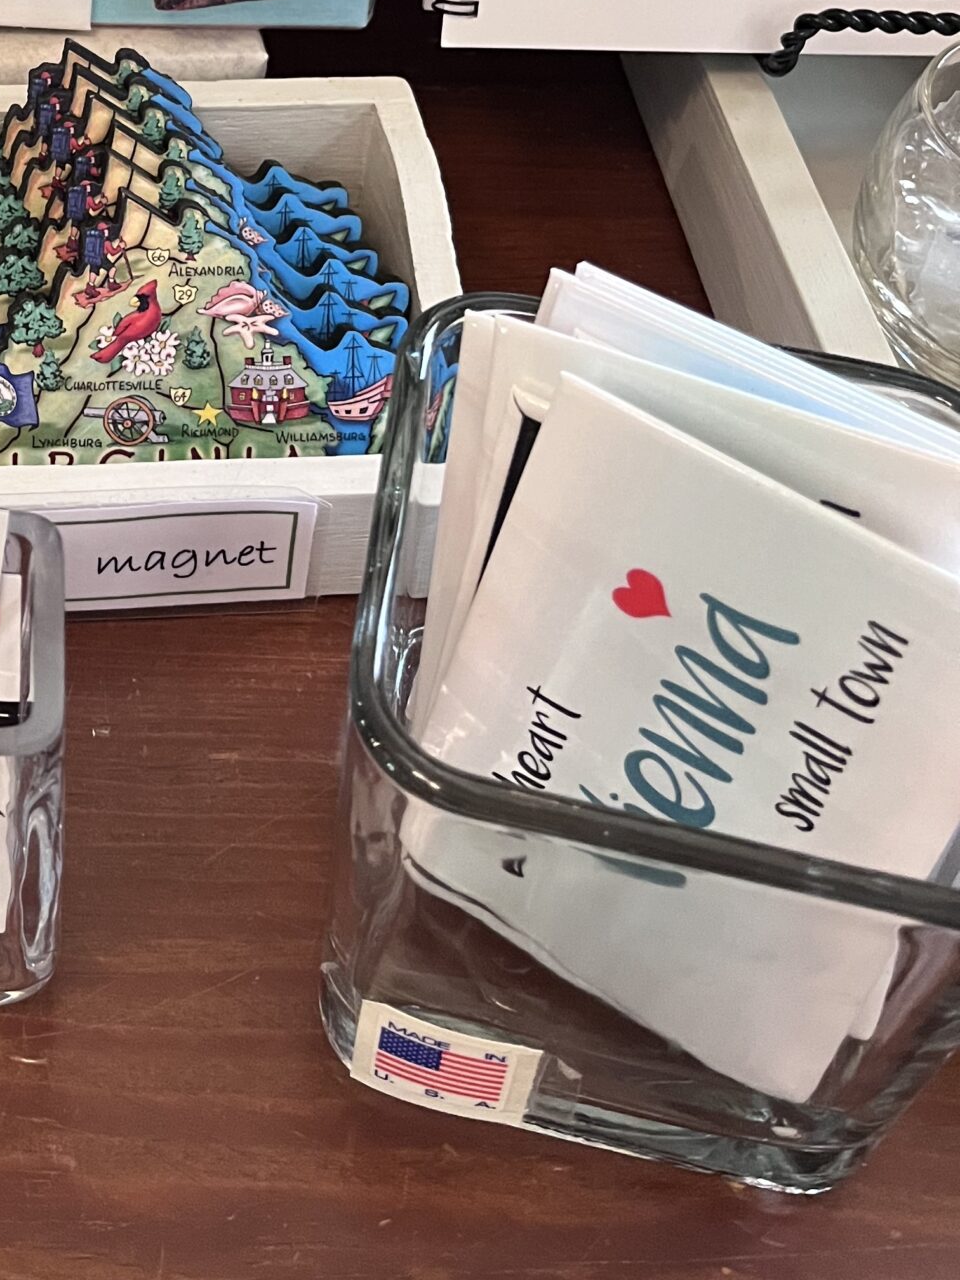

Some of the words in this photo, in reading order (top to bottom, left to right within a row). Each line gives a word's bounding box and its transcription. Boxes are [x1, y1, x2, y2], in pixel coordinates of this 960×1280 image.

[151, 251, 166, 262] 66
[168, 262, 245, 278] ALEXANDRIA
[177, 289, 193, 301] 29
[64, 375, 164, 392] CHARLOTTESVILLE
[173, 391, 188, 403] 64
[31, 435, 103, 449] LYNCHBURG
[275, 432, 368, 445] WILLIAMSBURG
[97, 540, 277, 579] magnet
[810, 620, 910, 725] town
[774, 720, 853, 833] small
[387, 1020, 452, 1051] MADE
[484, 1052, 508, 1064] IN
